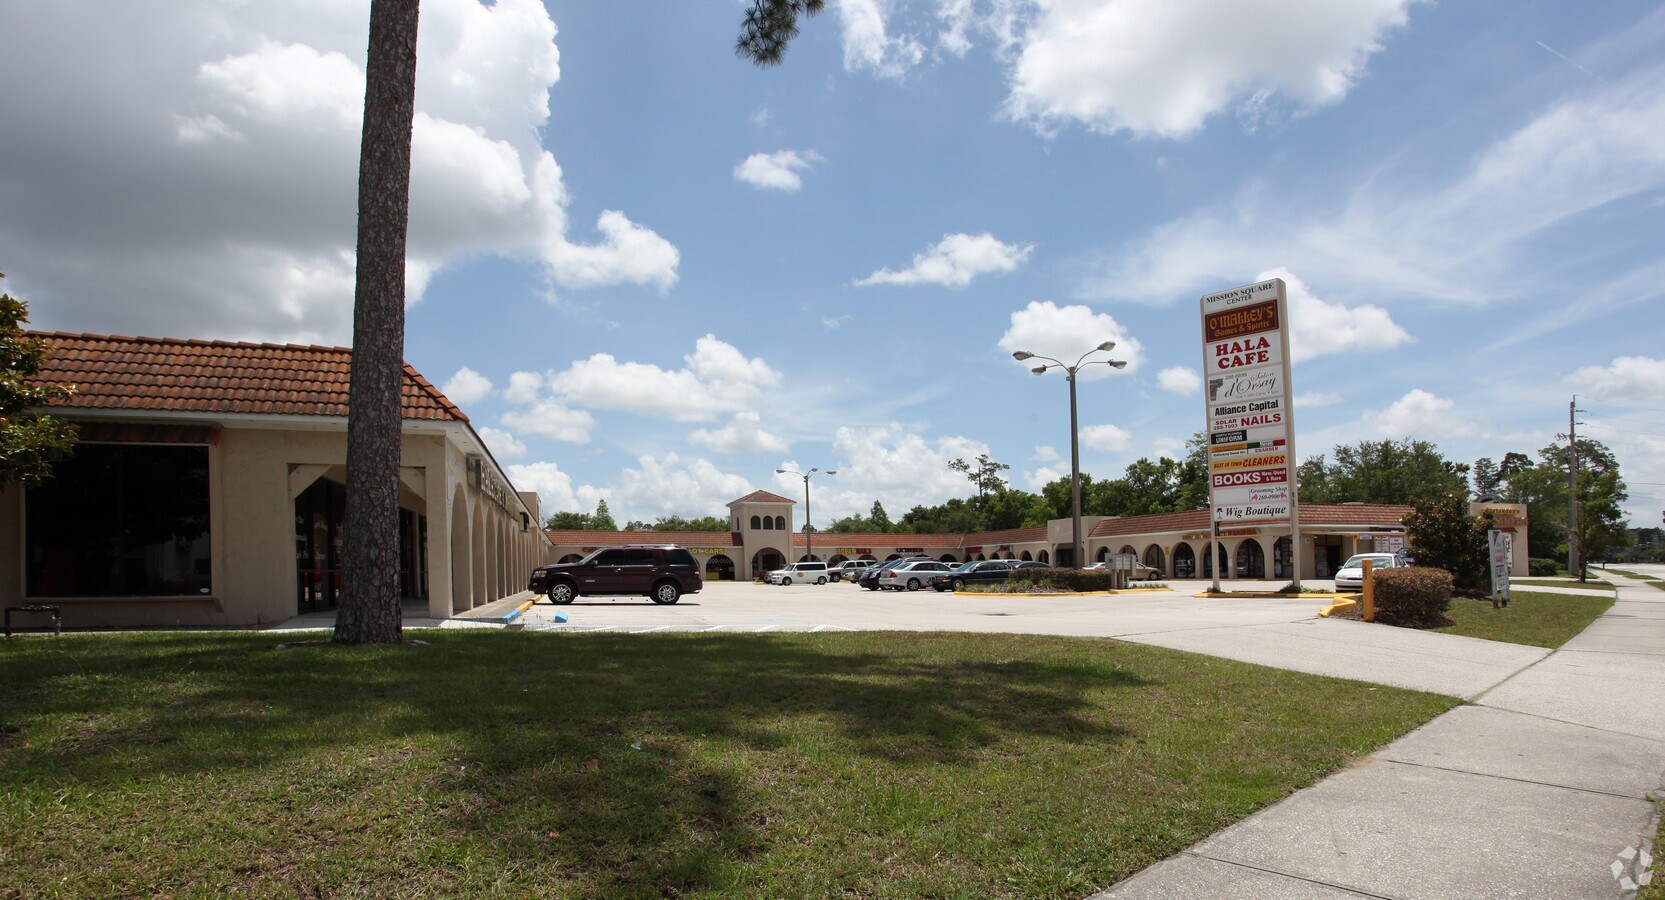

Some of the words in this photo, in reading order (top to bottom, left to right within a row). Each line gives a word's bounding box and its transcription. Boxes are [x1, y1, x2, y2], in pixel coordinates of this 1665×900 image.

[1206, 290, 1238, 303] MISSION
[1240, 282, 1274, 295] SQUARE
[1226, 294, 1252, 304] CENTER
[1210, 306, 1274, 330] O'MALLEY'S
[1214, 327, 1238, 337] Games
[1247, 320, 1270, 331] Spirits
[1216, 336, 1270, 356] HALA
[1218, 350, 1270, 369] CAFE
[1215, 405, 1247, 416] Alliance
[1249, 400, 1279, 412] Capital
[1240, 413, 1281, 426] NAILS
[1216, 435, 1243, 443] UNIFORM
[1243, 456, 1285, 467] CLEANERS
[1214, 472, 1261, 485] BOOKS
[1226, 507, 1242, 518] Wig
[1245, 506, 1286, 517] Boutique
